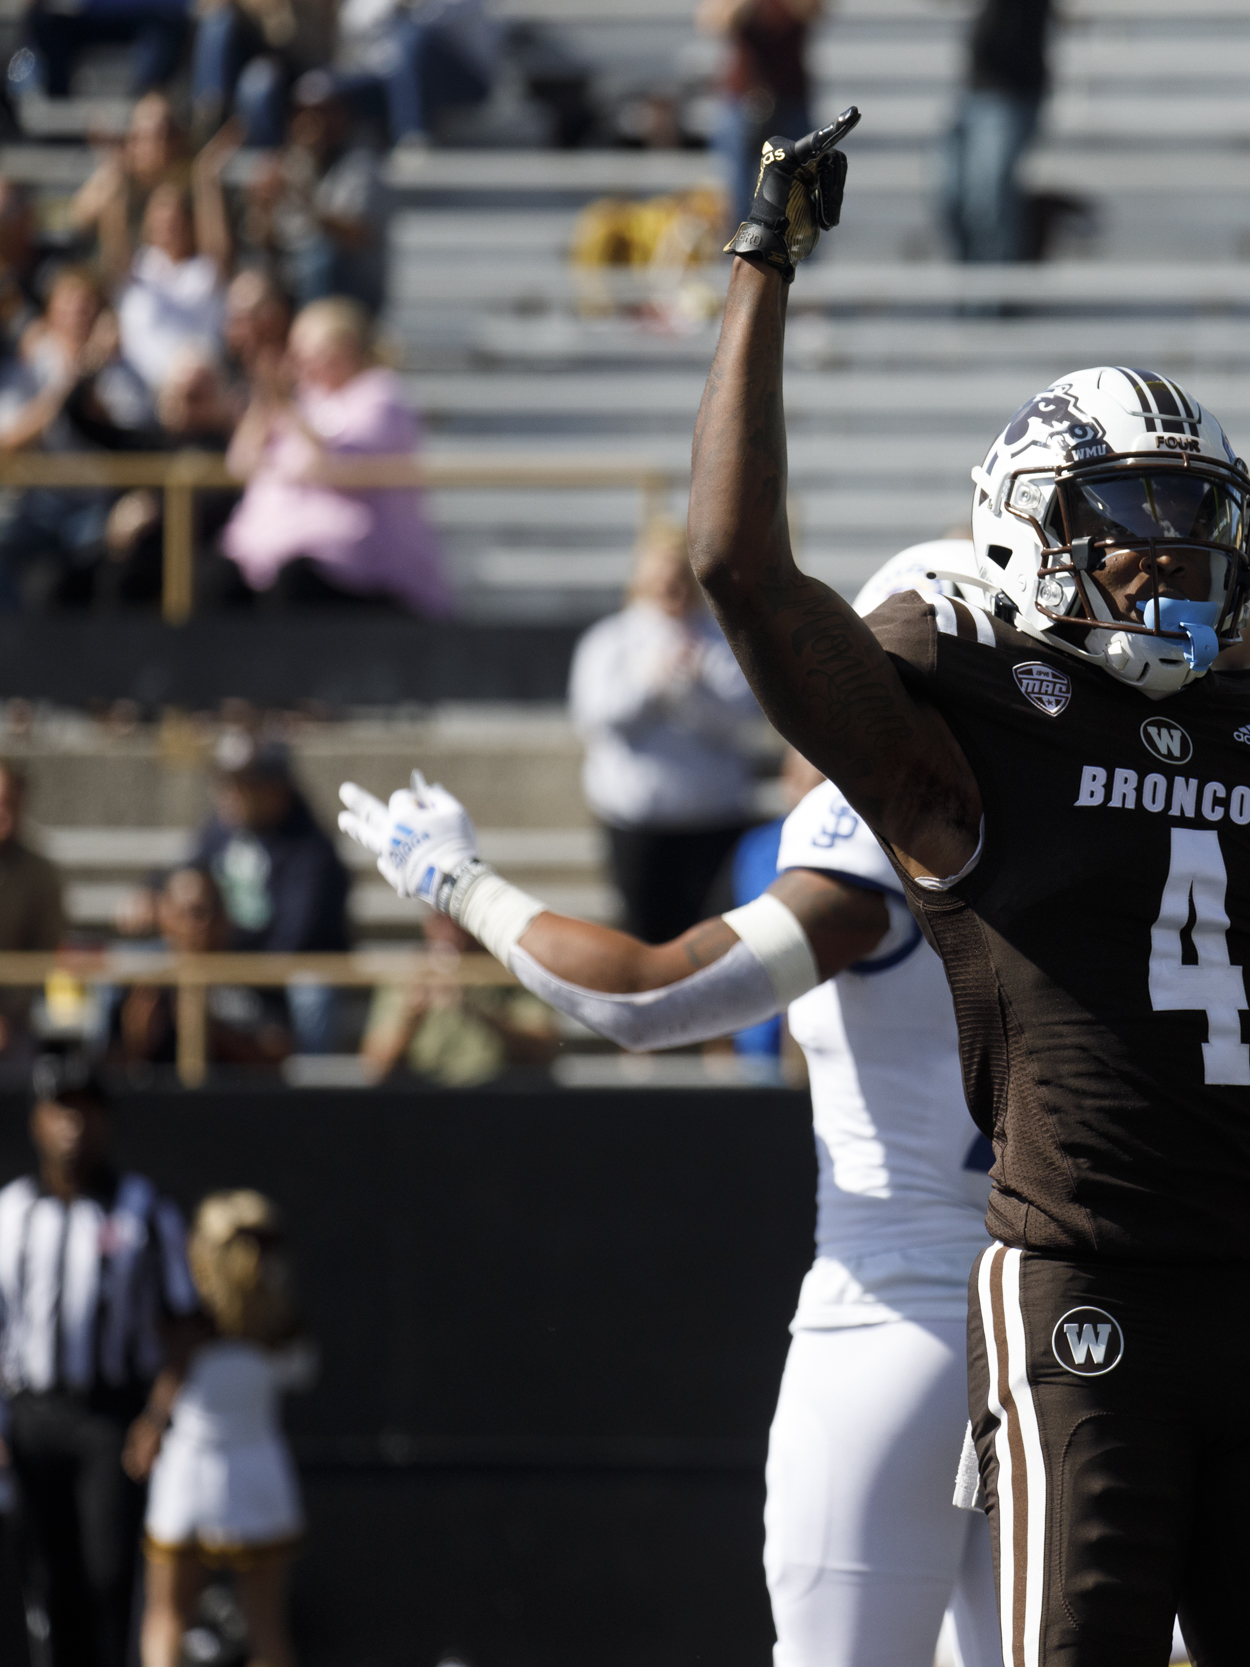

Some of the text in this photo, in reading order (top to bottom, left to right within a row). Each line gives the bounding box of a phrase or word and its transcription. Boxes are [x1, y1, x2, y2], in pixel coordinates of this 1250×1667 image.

[1071, 444, 1107, 461] WMU
[1156, 435, 1201, 453] FOUR
[1021, 679, 1069, 696] MAC
[1146, 725, 1181, 757] W
[1063, 1323, 1112, 1365] W
